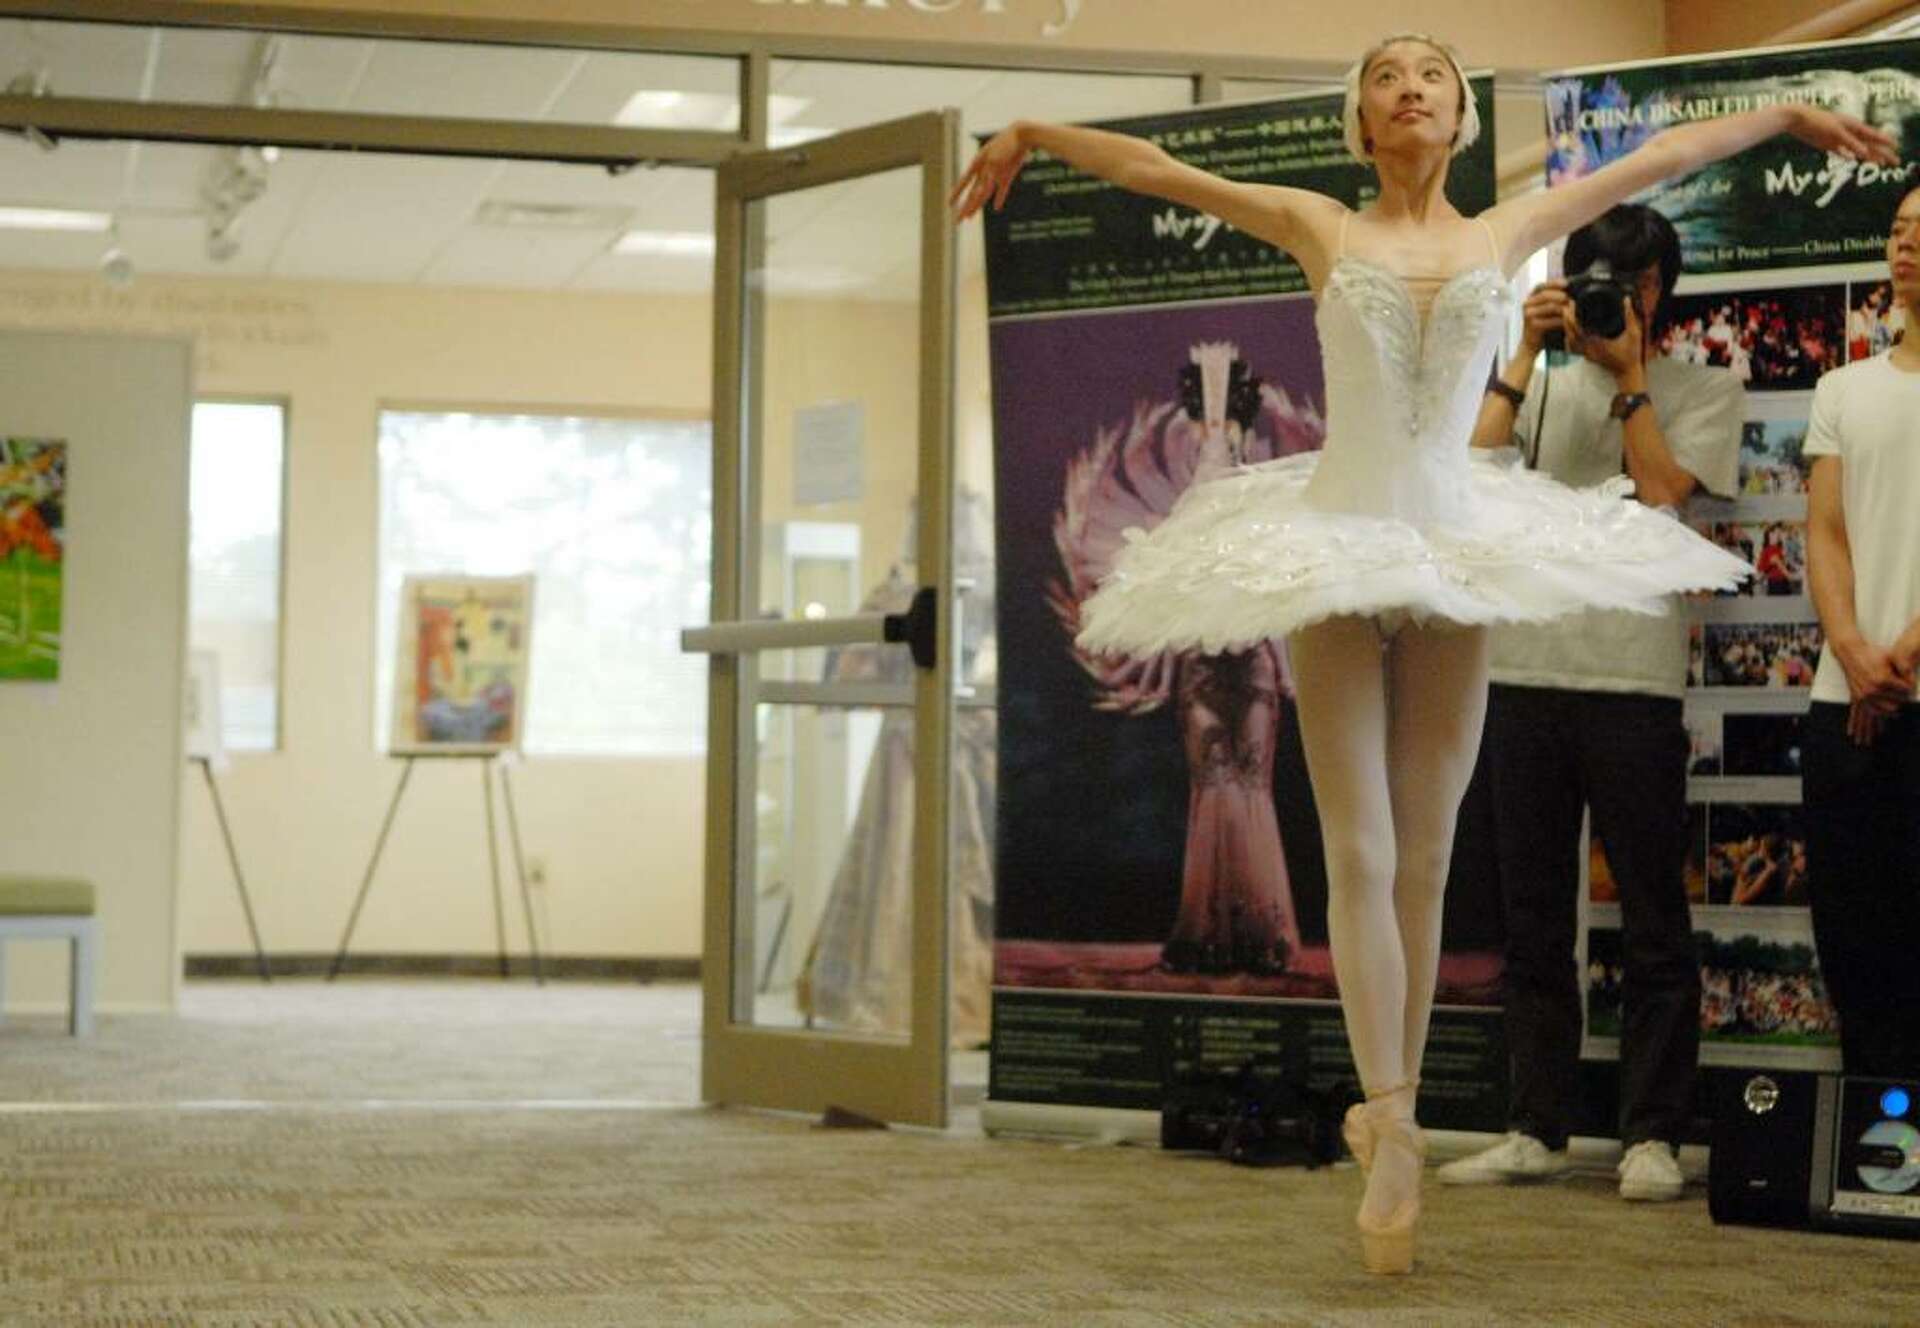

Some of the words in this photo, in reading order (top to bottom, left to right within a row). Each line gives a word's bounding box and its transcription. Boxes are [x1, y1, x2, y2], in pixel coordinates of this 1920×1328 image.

[1579, 104, 1645, 131] CHINA
[1649, 94, 1750, 125] DISABLED
[1765, 161, 1813, 196] My
